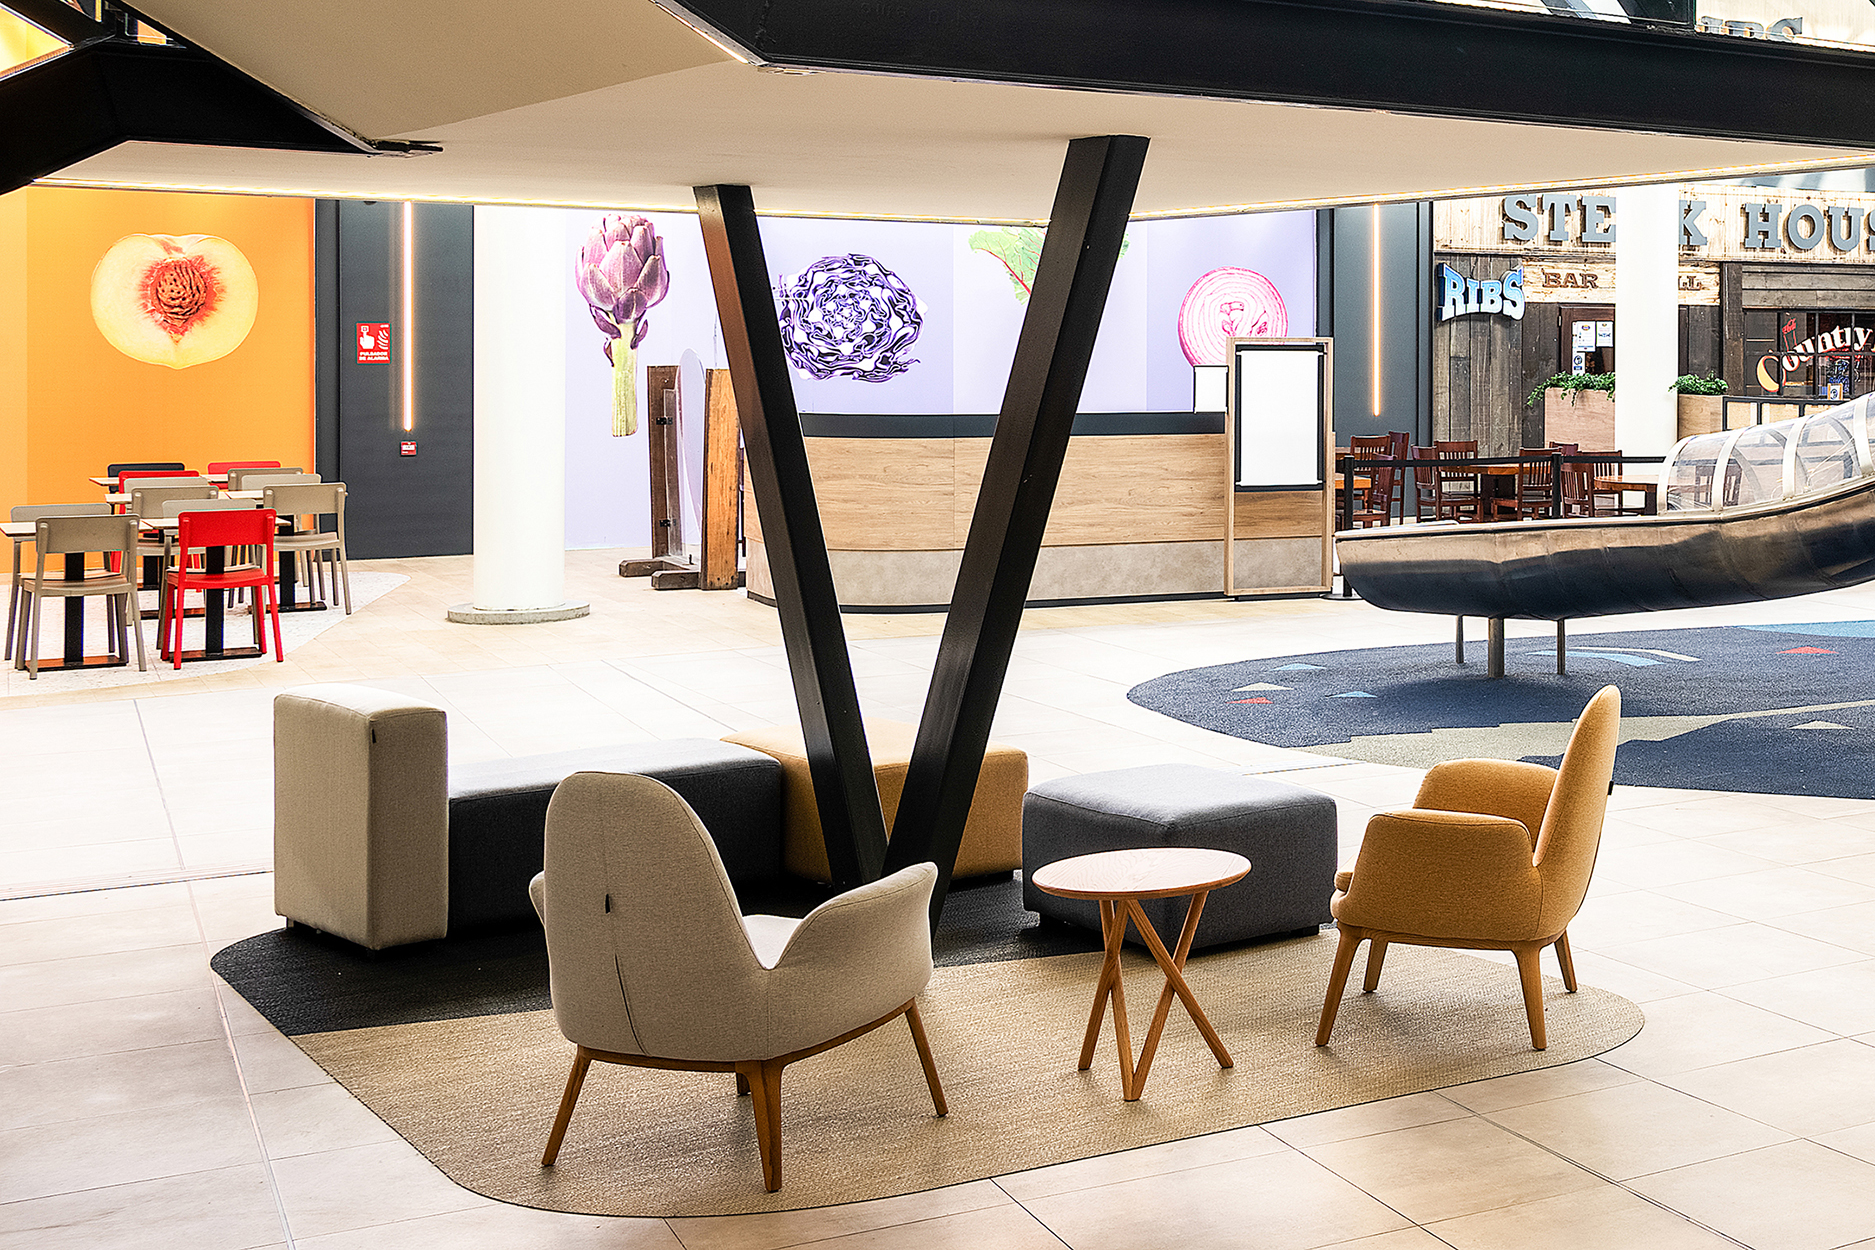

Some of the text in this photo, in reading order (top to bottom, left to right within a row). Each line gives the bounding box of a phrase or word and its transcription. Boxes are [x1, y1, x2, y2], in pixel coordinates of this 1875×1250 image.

[1503, 194, 1708, 246] STEK
[1439, 263, 1526, 321] RIBS
[1541, 270, 1600, 289] BAR
[1756, 325, 1873, 393] Country
